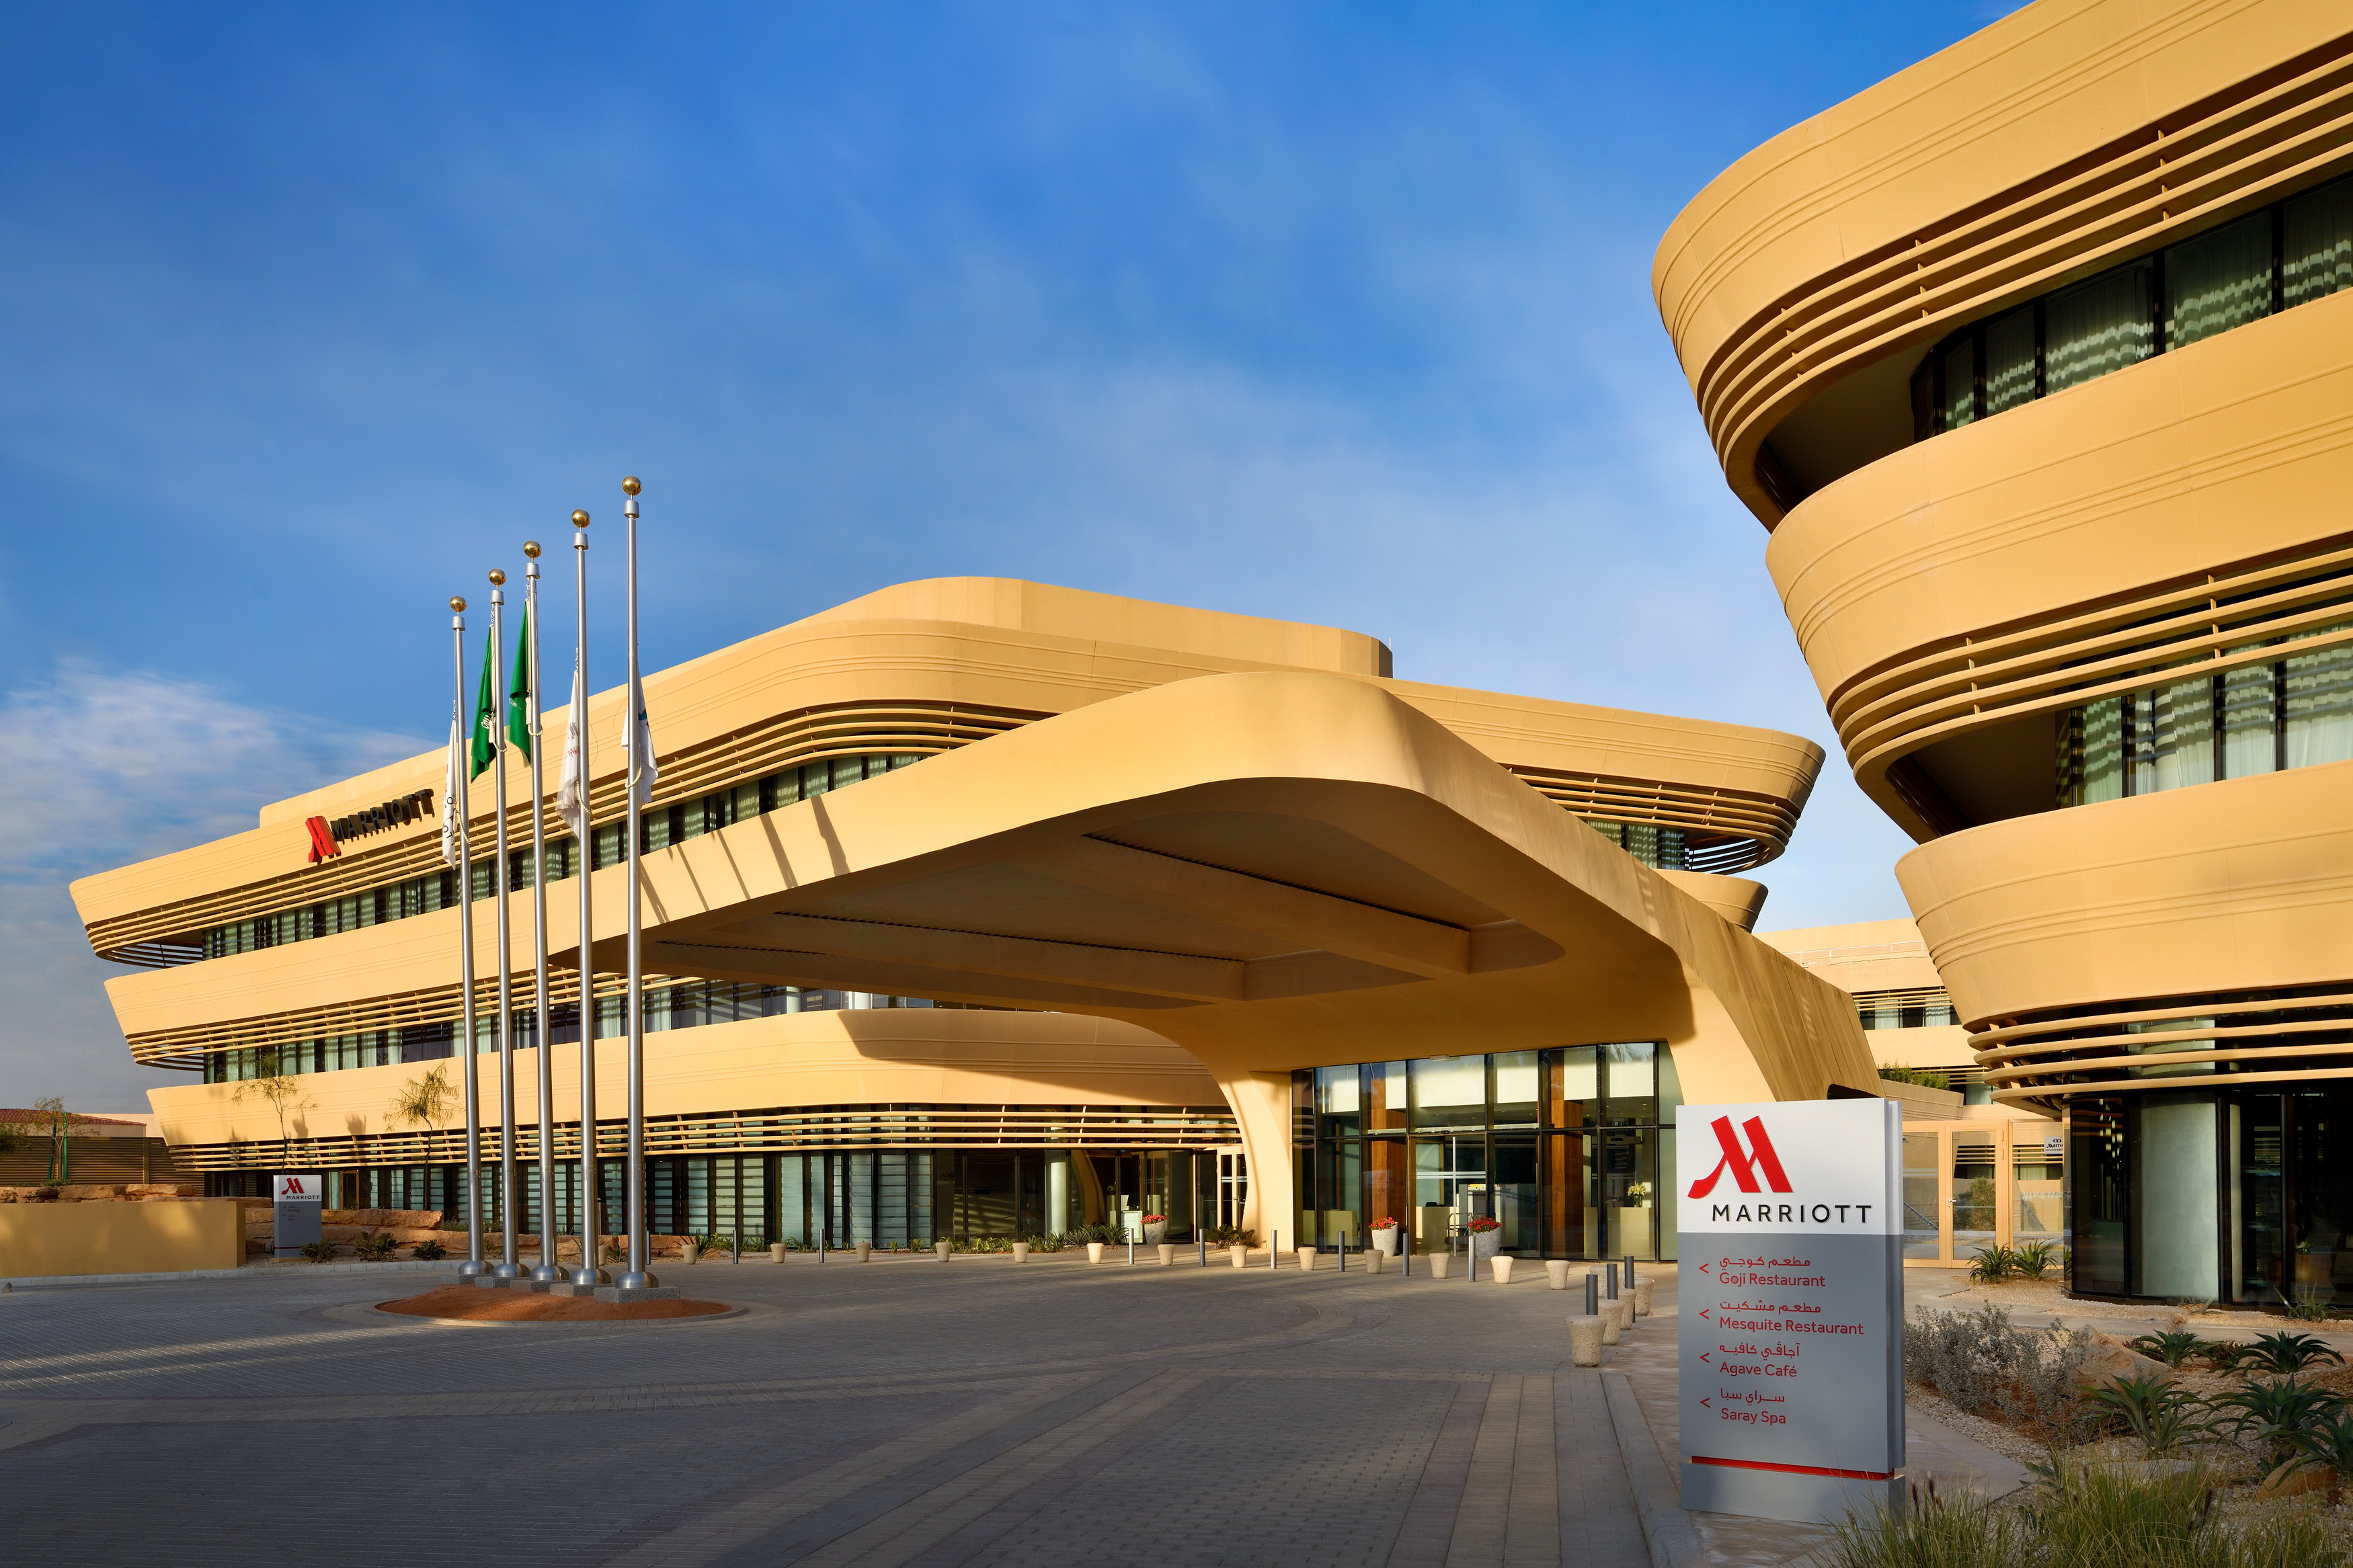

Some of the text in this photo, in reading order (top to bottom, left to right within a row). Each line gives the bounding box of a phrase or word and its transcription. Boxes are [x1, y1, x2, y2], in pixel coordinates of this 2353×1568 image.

[330, 788, 434, 842] MARRIOTT
[1712, 1204, 1873, 1224] MARRIOTT
[1719, 1256, 1810, 1271] مطعم كوجي
[1719, 1272, 1826, 1287] Goji Restaurant
[1779, 1303, 1821, 1315] مطعم
[1720, 1317, 1864, 1335] Mesquite Restaurant
[1719, 1342, 1757, 1356] كافيه
[1720, 1362, 1797, 1377] Agave Café
[1720, 1387, 1785, 1406] سراي سبا
[1721, 1407, 1786, 1426] Saray Spa
